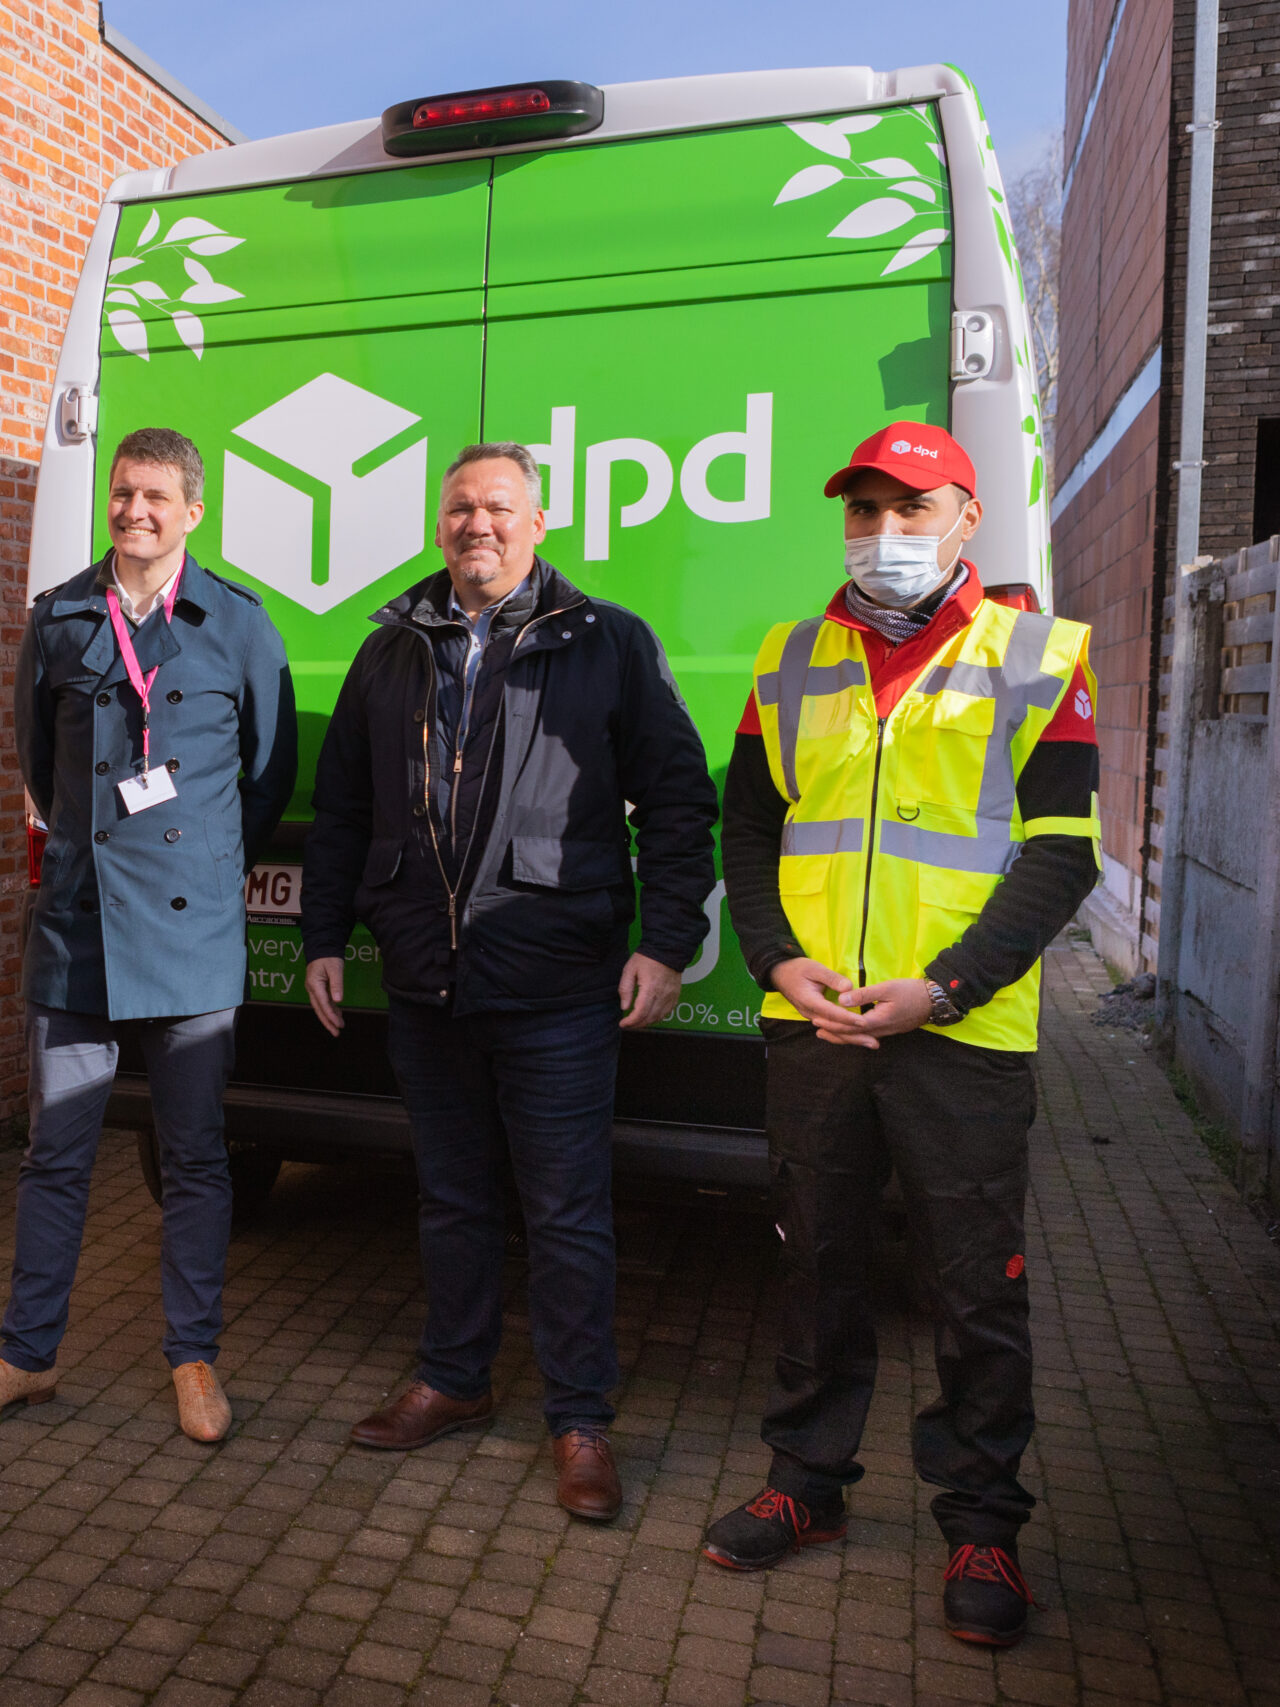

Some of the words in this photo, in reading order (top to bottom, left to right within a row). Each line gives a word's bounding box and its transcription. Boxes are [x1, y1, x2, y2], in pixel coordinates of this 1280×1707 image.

[912, 444, 938, 459] dpd
[523, 391, 774, 562] dpd
[246, 870, 293, 907] MG
[248, 938, 304, 963] very
